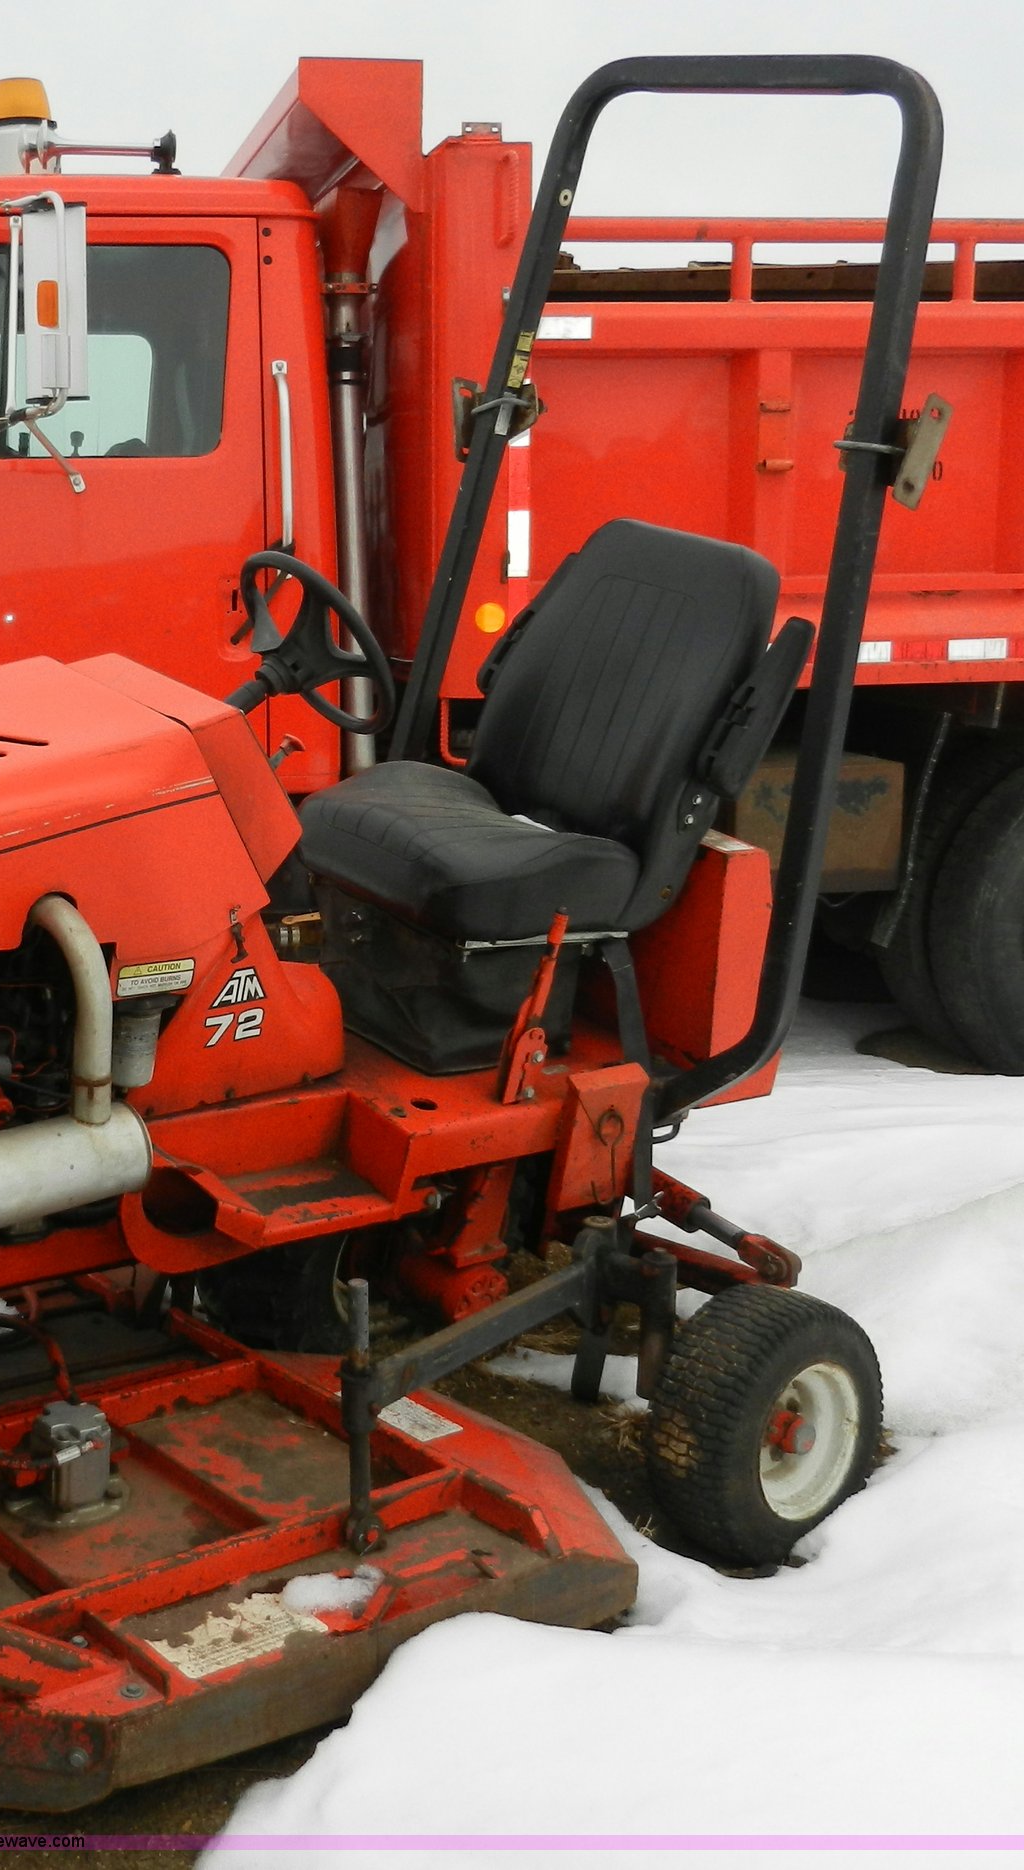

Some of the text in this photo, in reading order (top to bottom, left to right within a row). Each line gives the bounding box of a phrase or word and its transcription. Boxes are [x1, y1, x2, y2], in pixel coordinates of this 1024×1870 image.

[130, 979, 140, 987] TO
[140, 977, 159, 985] AVOID
[159, 974, 182, 983] BURNS
[147, 962, 182, 974] CAUTION
[209, 967, 267, 1009] ATM
[204, 1007, 265, 1049] 72
